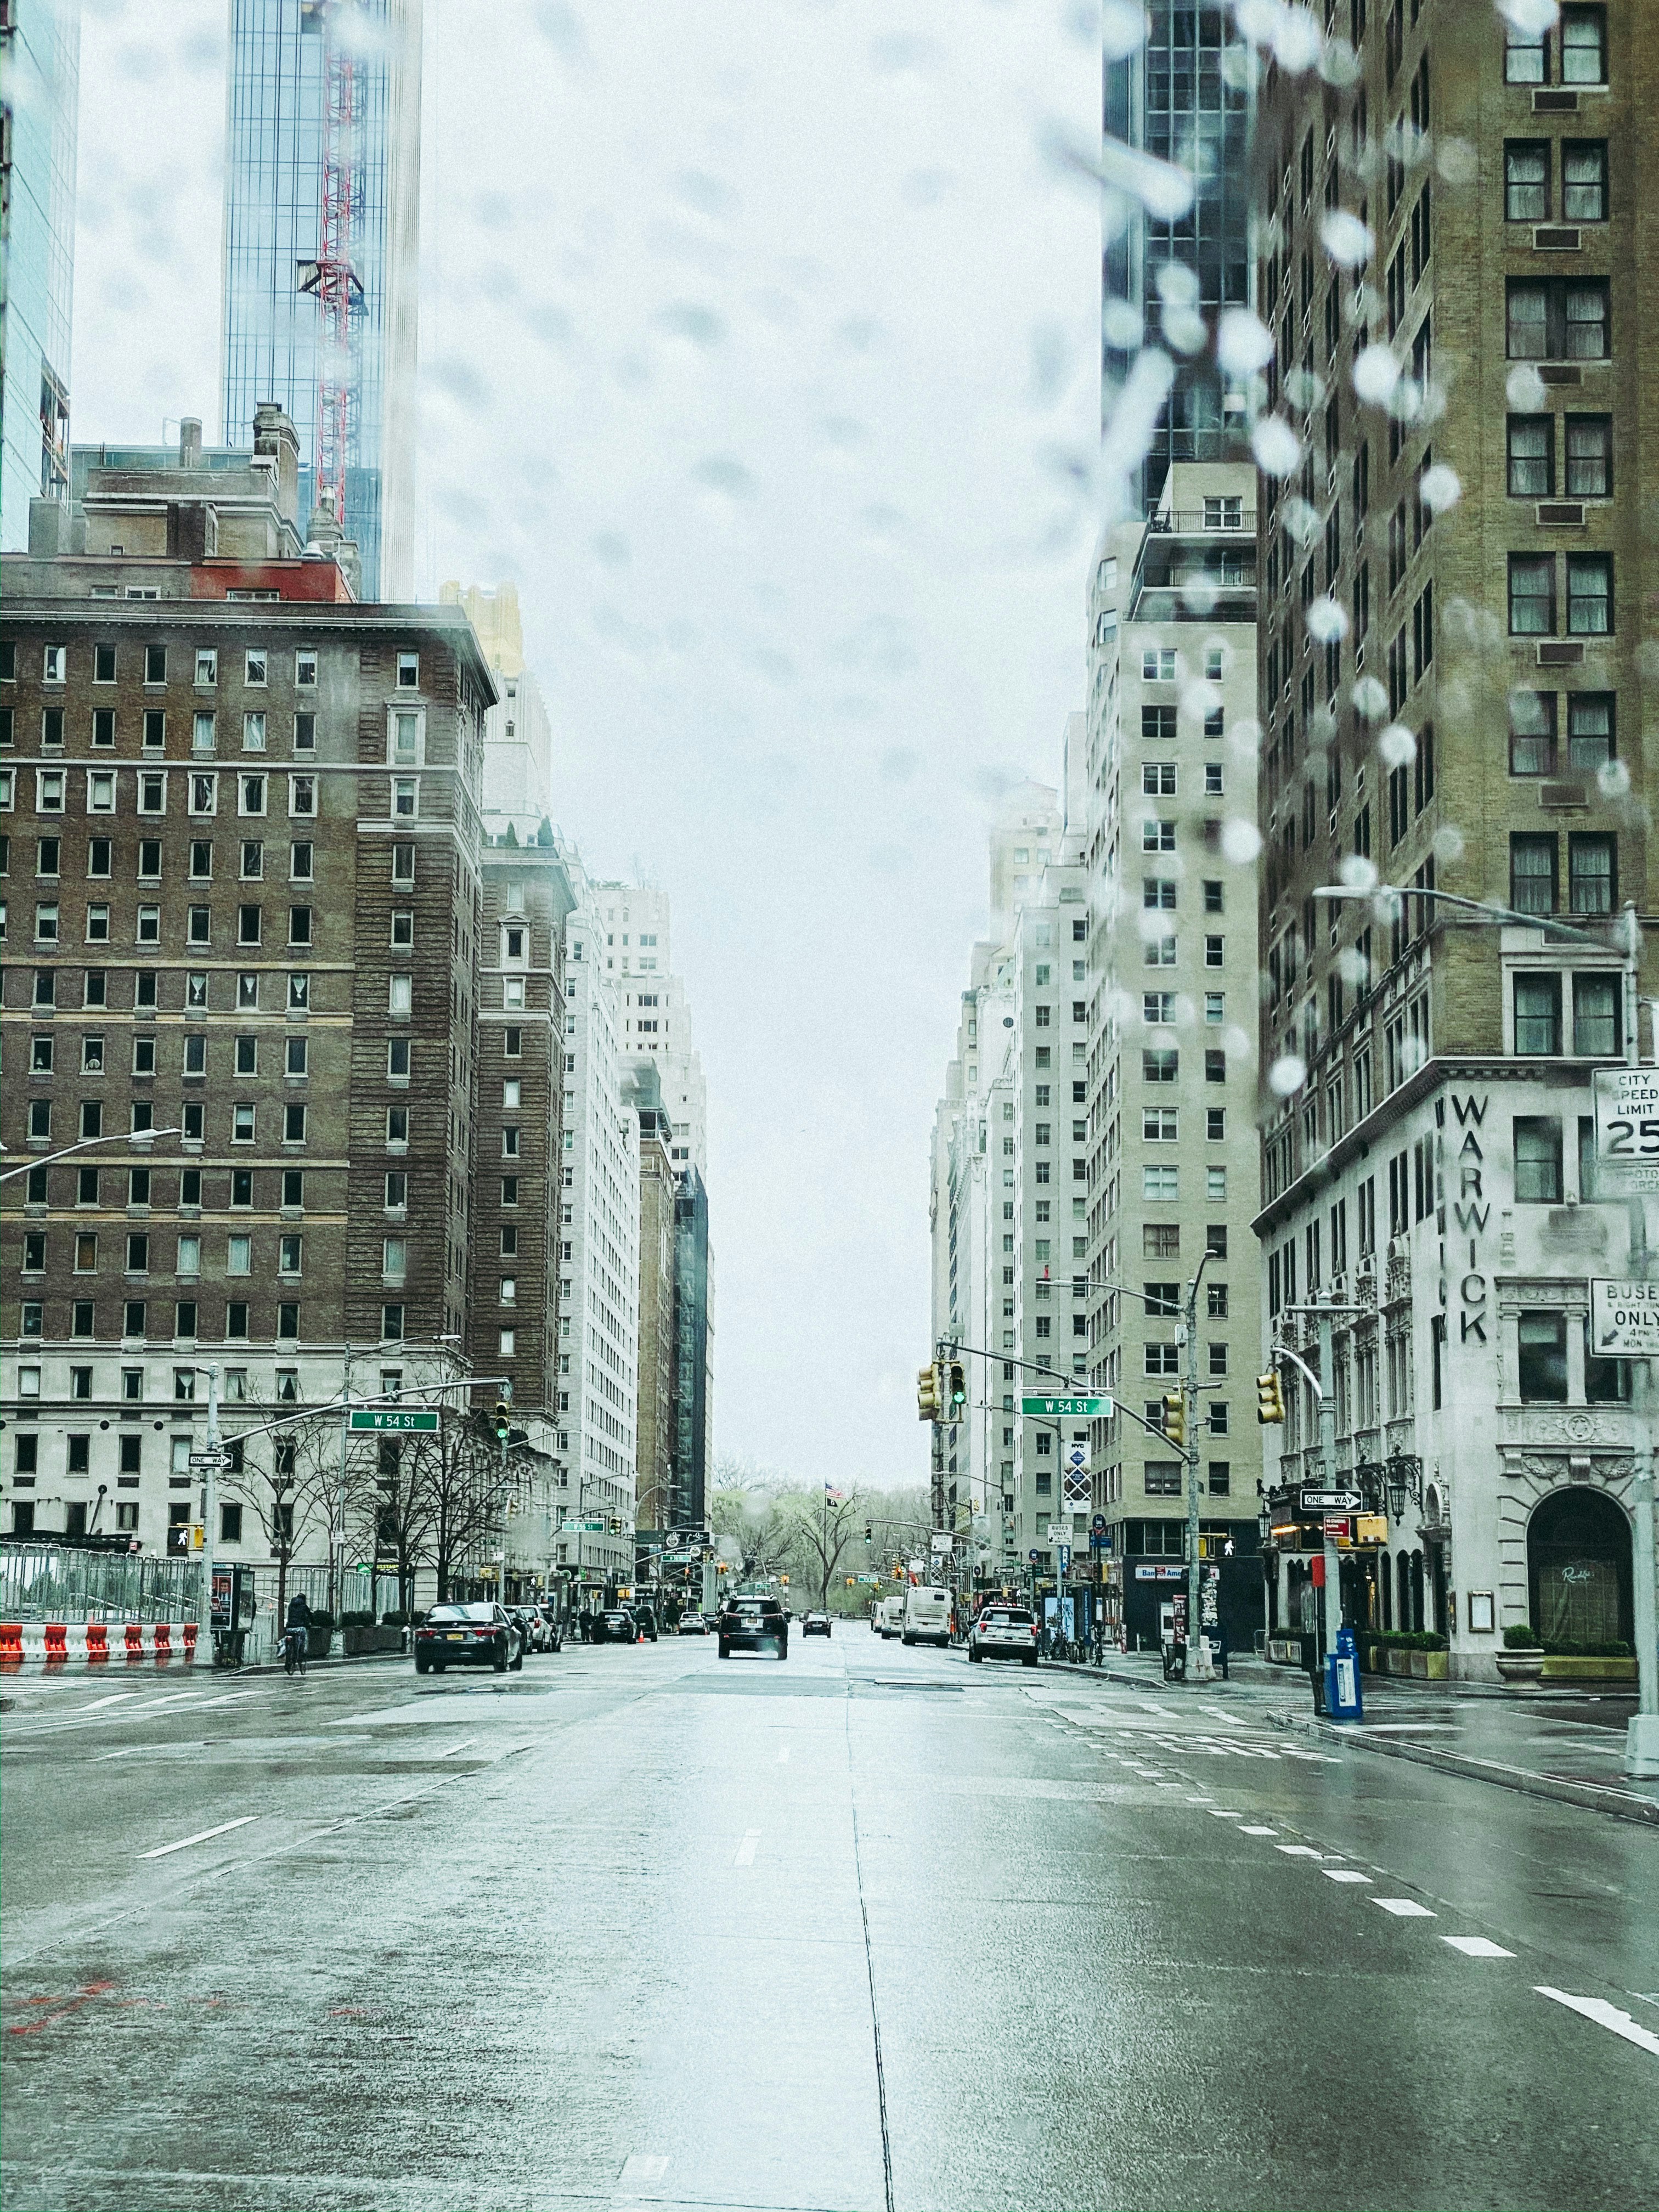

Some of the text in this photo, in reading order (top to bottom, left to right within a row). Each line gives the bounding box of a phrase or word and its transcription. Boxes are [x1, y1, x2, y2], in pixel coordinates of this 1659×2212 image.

[1619, 1074, 1651, 1086] CITY
[1617, 1104, 1655, 1115] LIMIT
[1607, 1120, 1659, 1154] 25
[1452, 1094, 1491, 1344] WARWICK
[1607, 1285, 1657, 1300] BUSE
[1615, 1310, 1659, 1327] ONLY
[1045, 1401, 1088, 1413] W 54 St
[374, 1415, 415, 1427] W 54 St
[1307, 1496, 1353, 1504] ONE WAY
